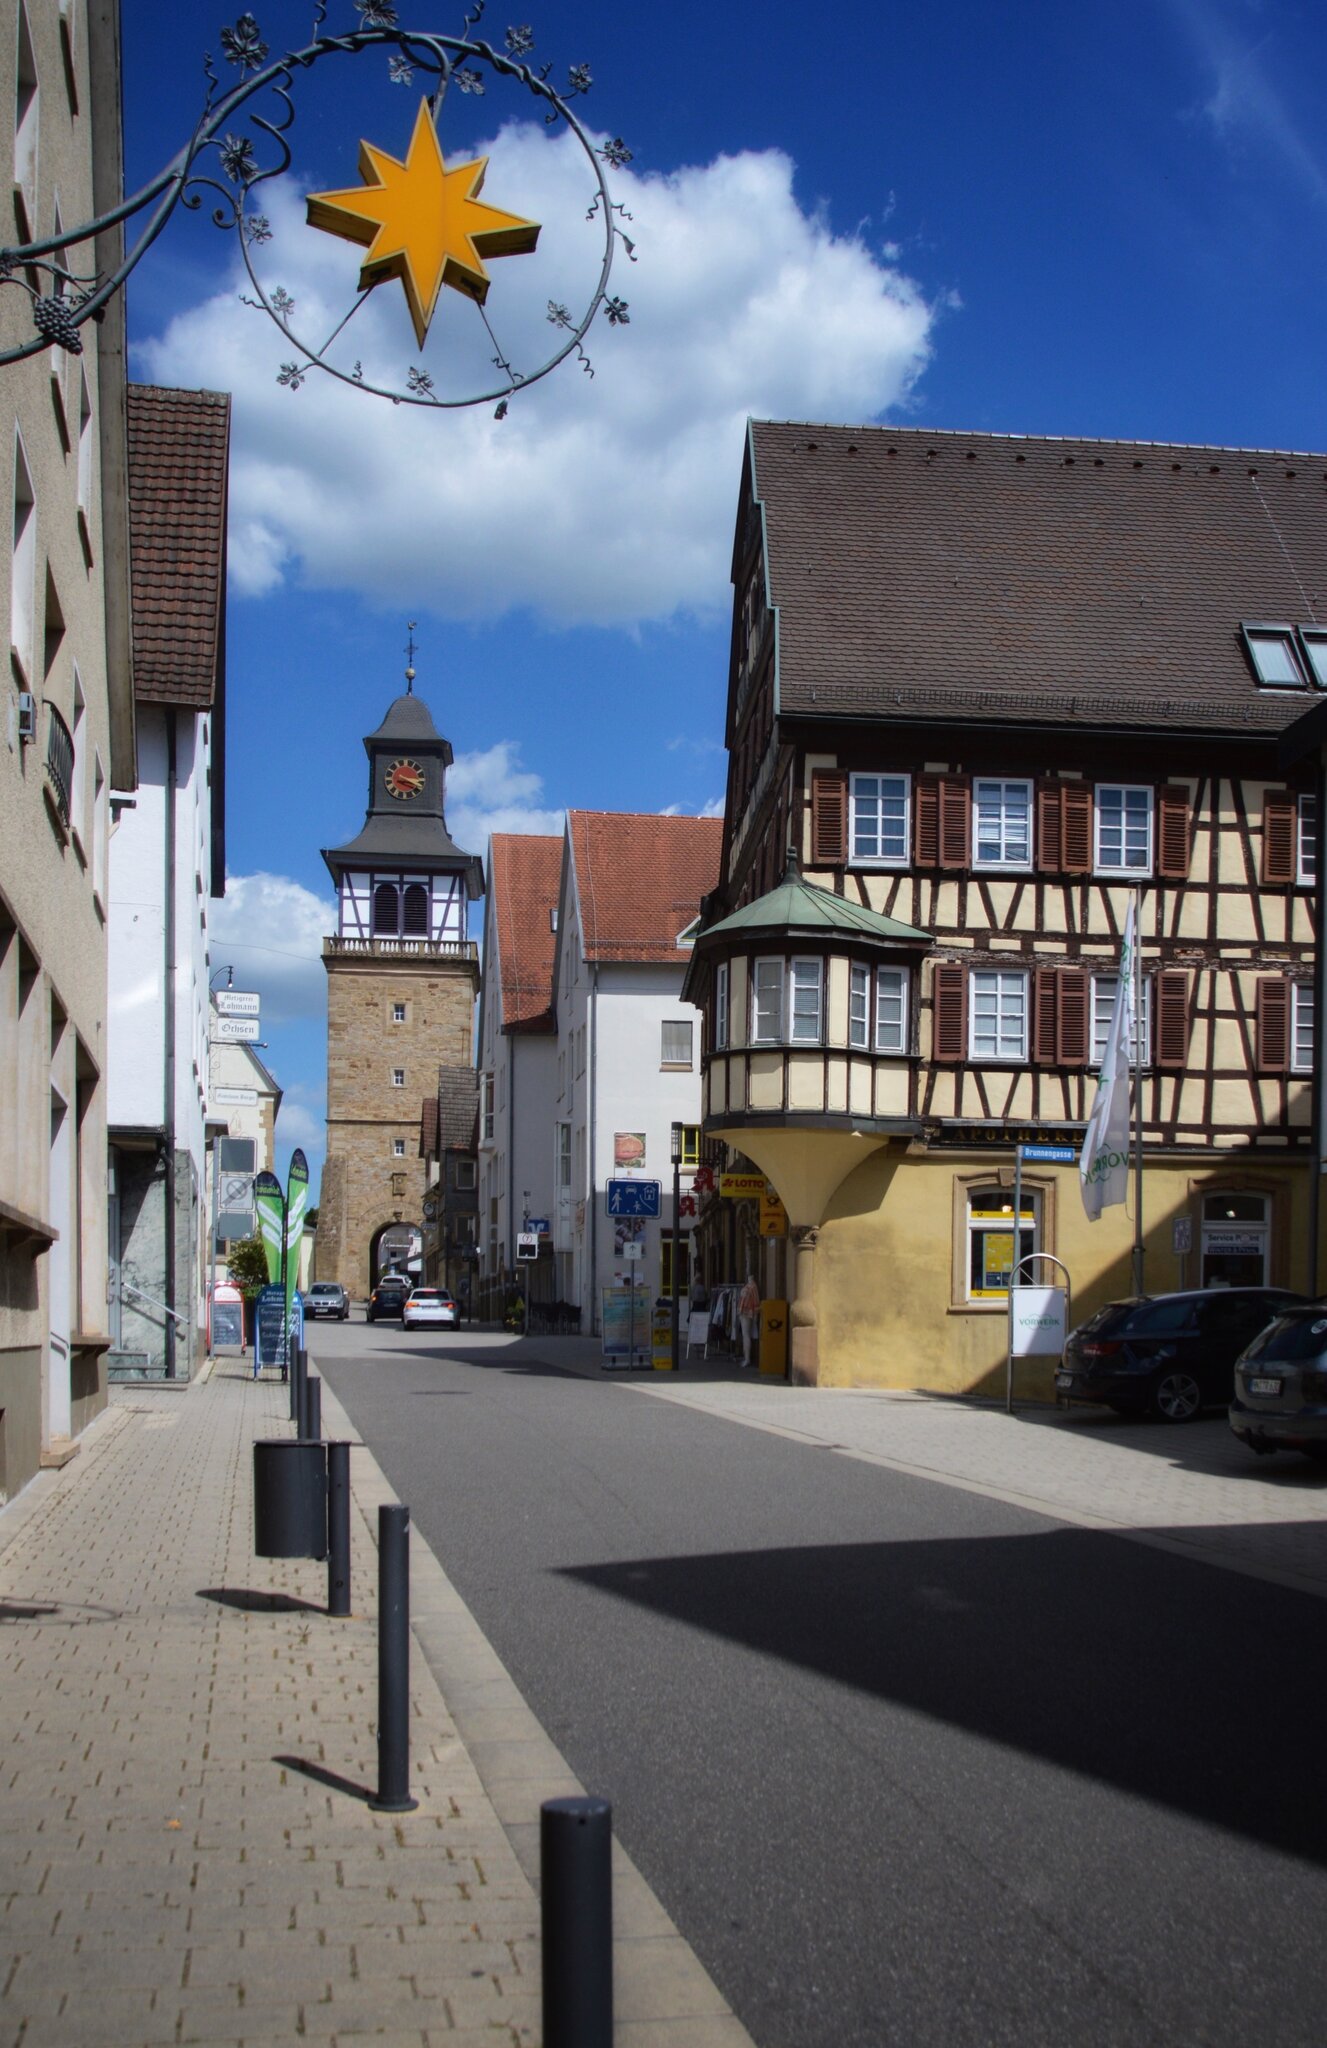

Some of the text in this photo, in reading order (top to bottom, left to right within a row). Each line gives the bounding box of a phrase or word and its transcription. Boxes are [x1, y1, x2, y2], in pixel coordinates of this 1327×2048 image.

[219, 1001, 257, 1011] Lohmann
[221, 1023, 255, 1034] Ochsen
[953, 1127, 1084, 1142] APOTHEKE
[1025, 1147, 1072, 1159] Brunnengasse
[735, 1178, 764, 1189] LOTTO
[1207, 1233, 1234, 1241] Service
[1018, 1318, 1061, 1326] VORWERK
